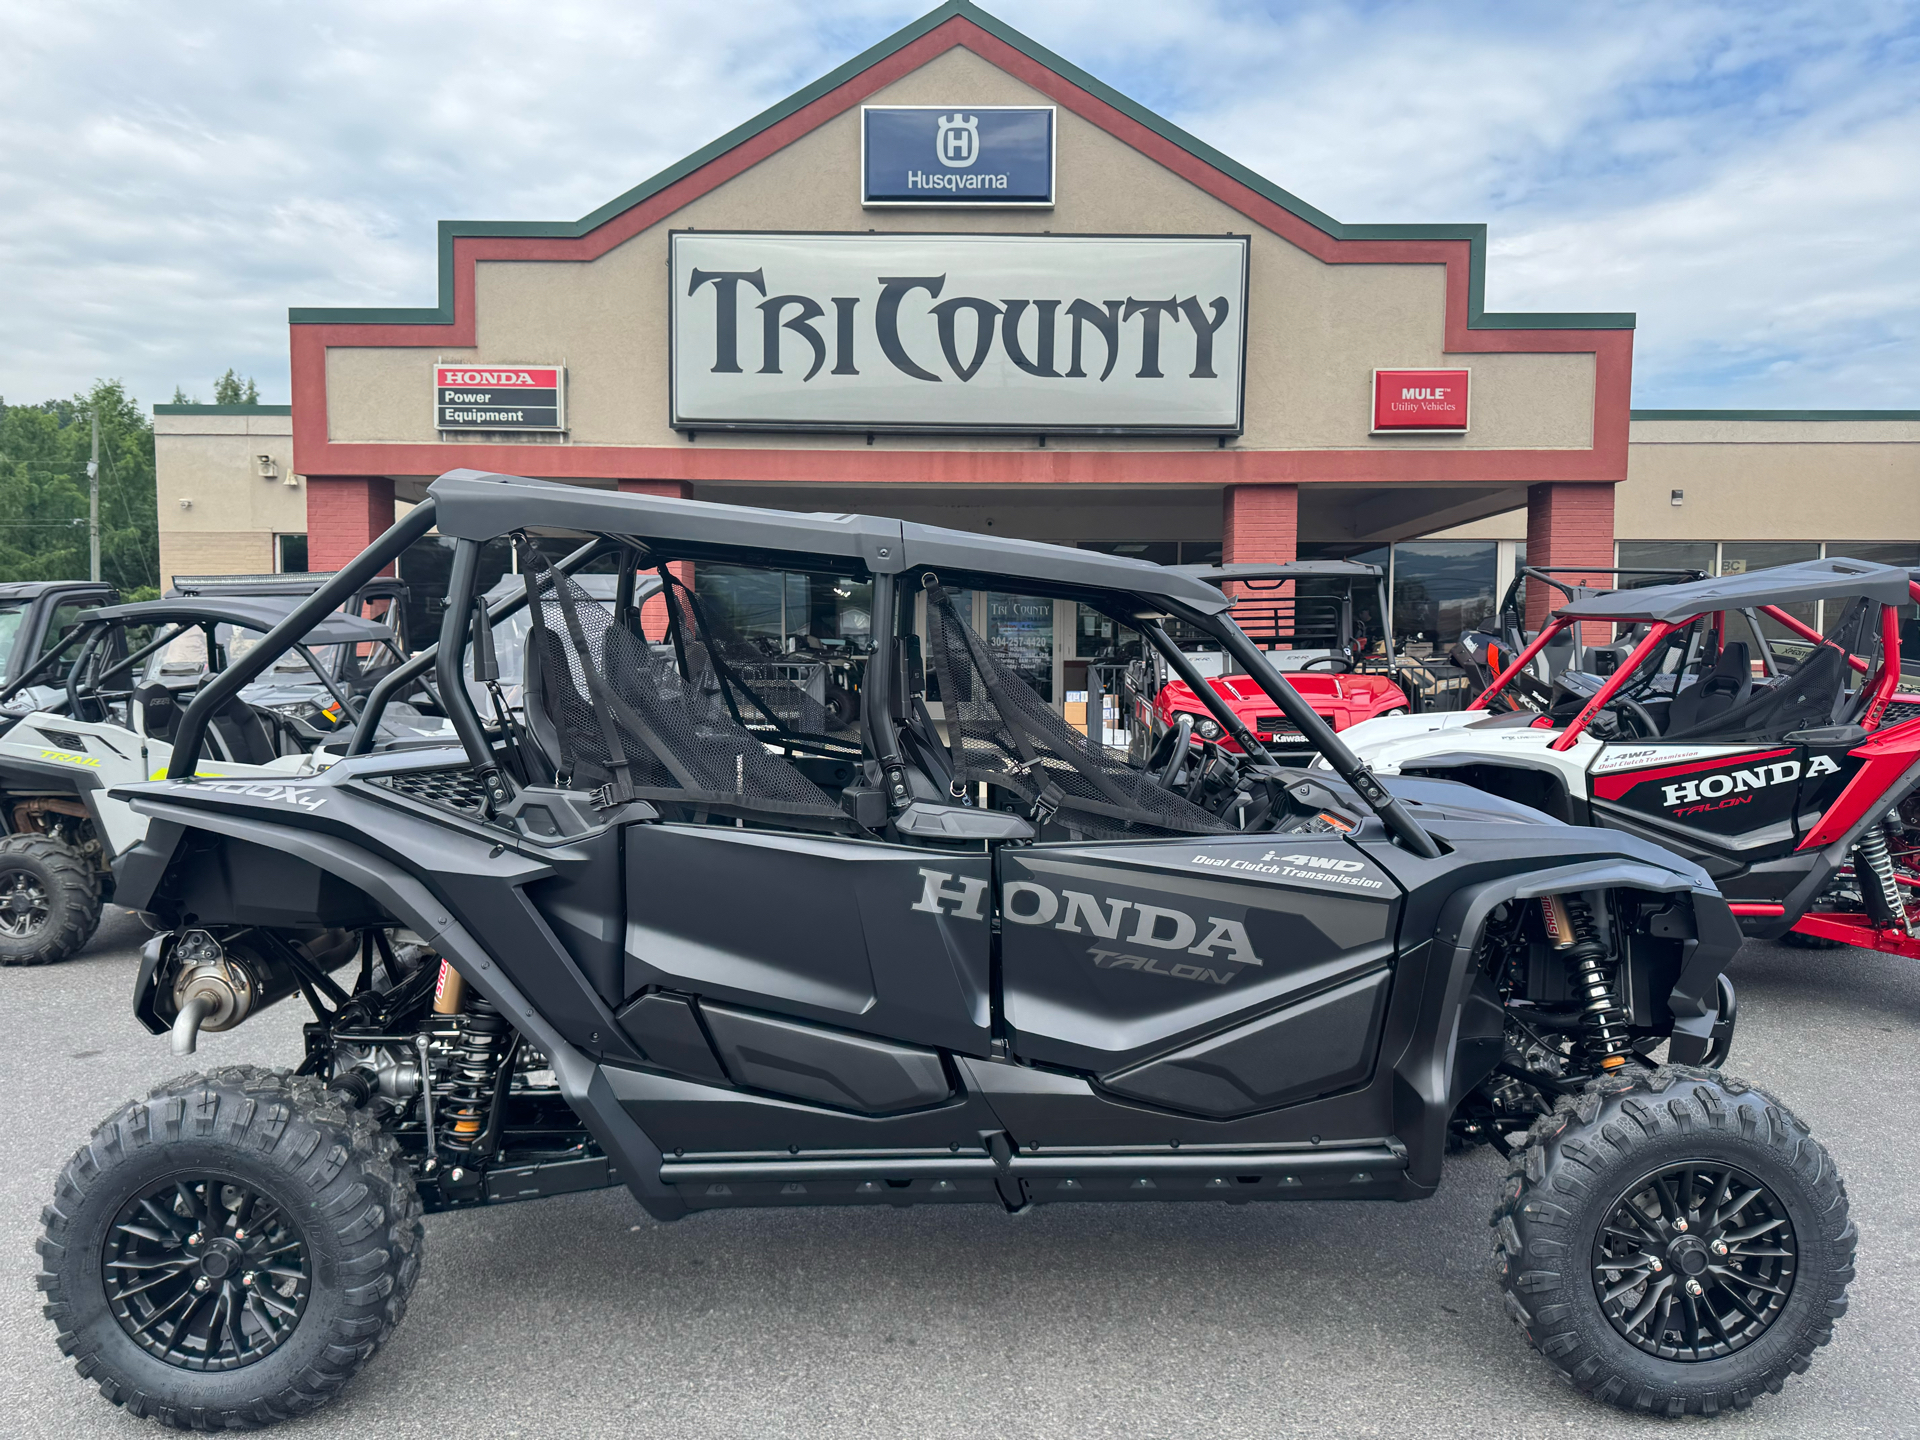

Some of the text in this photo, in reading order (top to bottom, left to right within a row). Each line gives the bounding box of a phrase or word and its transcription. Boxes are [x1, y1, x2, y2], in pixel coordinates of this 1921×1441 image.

[908, 171, 1007, 192] Husqvarna
[688, 267, 1229, 382] TRI COUNTY
[445, 372, 535, 384] HONDA
[445, 391, 491, 403] Power
[445, 409, 523, 423] Equipment
[1391, 402, 1456, 412] Utility Vehicles
[1722, 560, 1740, 571] BC
[990, 636, 1047, 647] 304-257-4420
[1273, 733, 1309, 743] Kawas
[40, 750, 101, 767] TRAIL
[1598, 751, 1699, 770] Dual Clutch Transmission
[1661, 754, 1841, 807] HONDA
[1672, 795, 1753, 818] TALON
[1191, 854, 1383, 889] Dual Clutch Transmission
[911, 867, 1263, 967] HONDA
[1085, 949, 1236, 985] TALON
[436, 957, 449, 998] SHO
